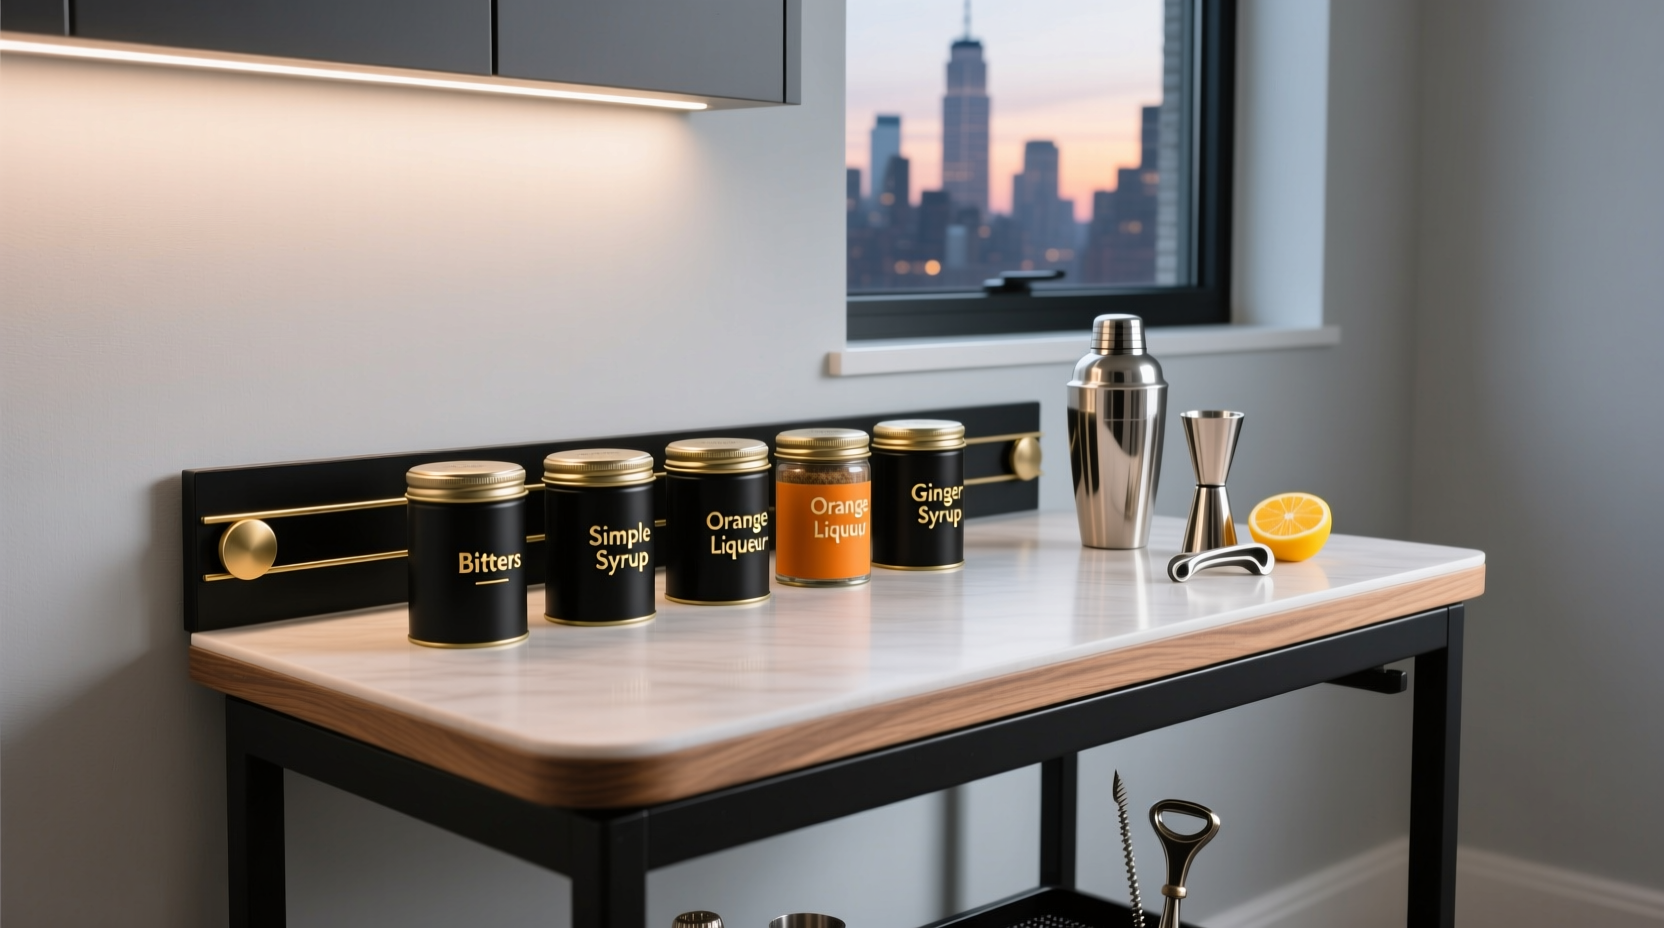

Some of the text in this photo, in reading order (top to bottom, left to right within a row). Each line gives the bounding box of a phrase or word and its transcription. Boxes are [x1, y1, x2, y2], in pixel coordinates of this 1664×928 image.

[811, 496, 869, 518] Orange
[911, 483, 964, 507] Ginger
[706, 511, 768, 534] Orange
[918, 505, 962, 529] Syrup
[589, 521, 651, 549] Simple
[711, 535, 769, 560] Liqueur
[458, 551, 522, 574] Bitters
[595, 549, 649, 576] Syrup
